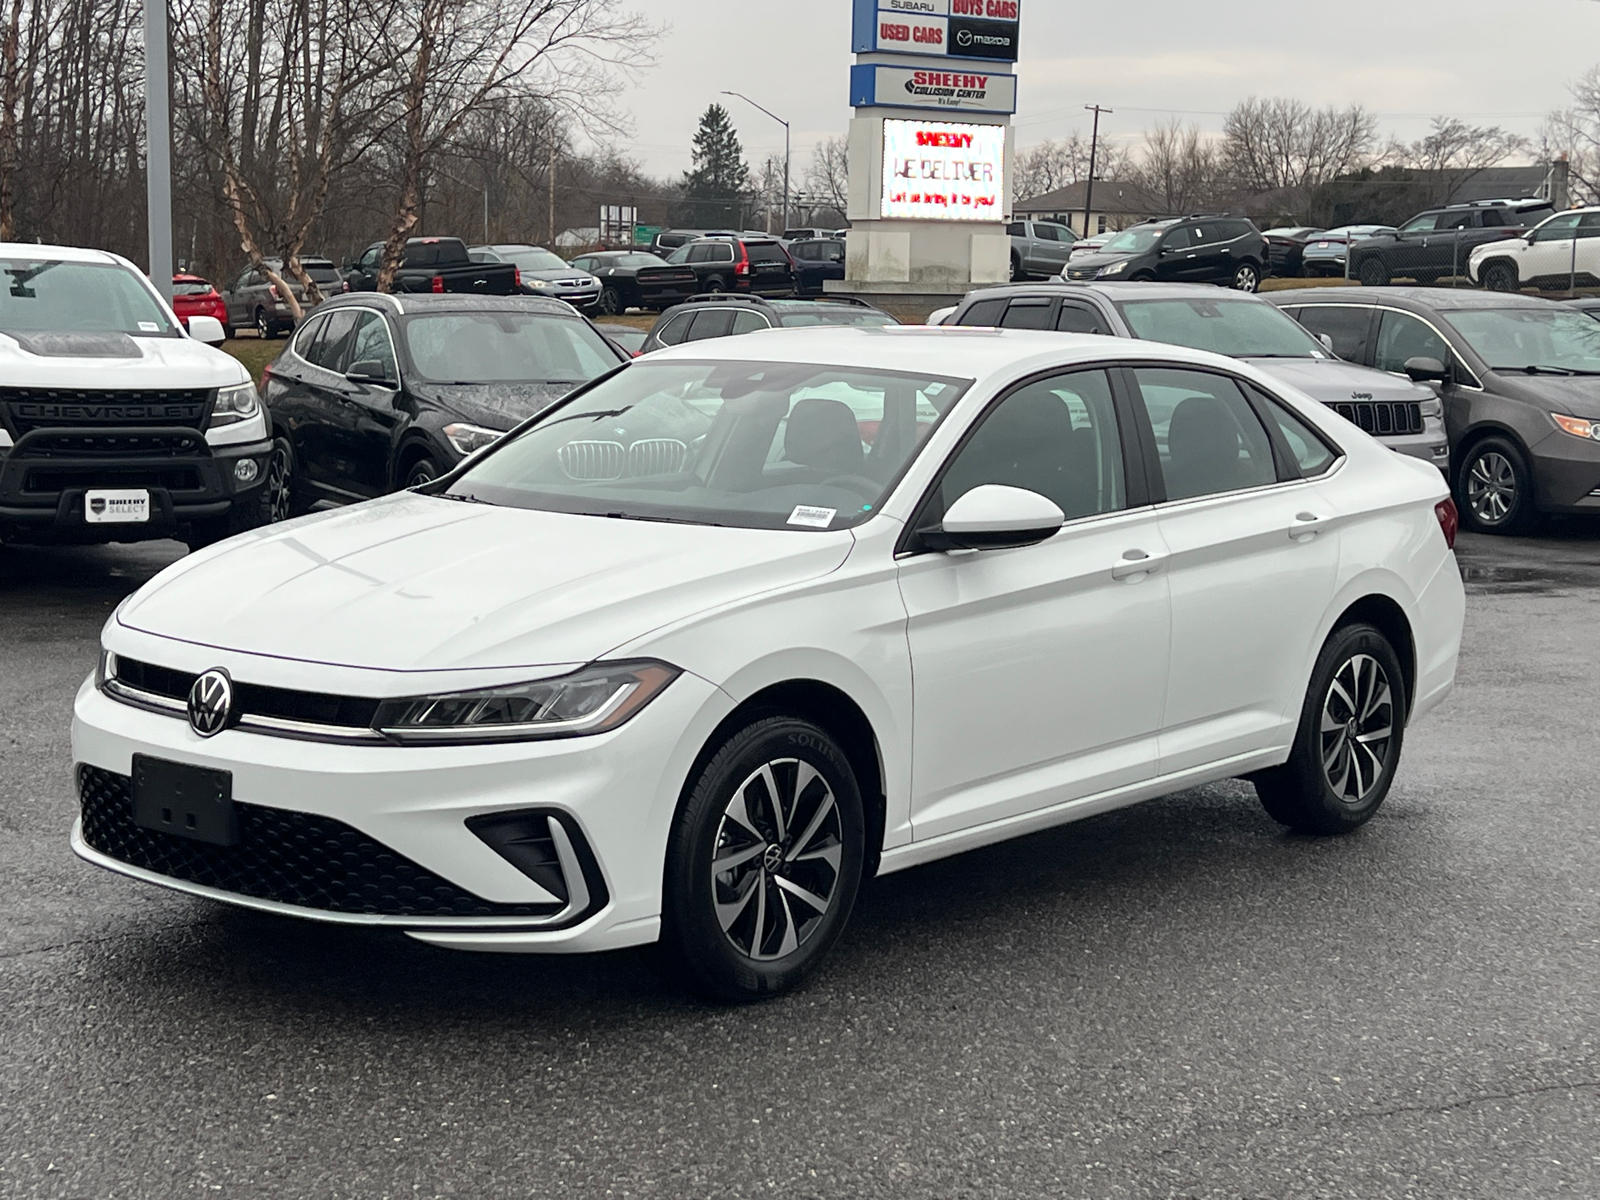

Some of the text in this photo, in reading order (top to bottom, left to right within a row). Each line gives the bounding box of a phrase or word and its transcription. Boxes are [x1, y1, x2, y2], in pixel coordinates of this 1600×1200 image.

[891, 0, 935, 12] SUBARU
[953, 0, 1017, 19] BUYS CARS
[880, 23, 943, 45] USED CARS
[974, 35, 1011, 46] mazda
[914, 71, 988, 89] SHEEHY
[914, 86, 986, 99] COLLISION CENTER
[920, 159, 993, 182] DELIVER
[1351, 391, 1372, 400] Jeep
[18, 404, 199, 419] CHEVROLET
[109, 505, 146, 514] SELECT
[788, 733, 834, 761] SOLUS
